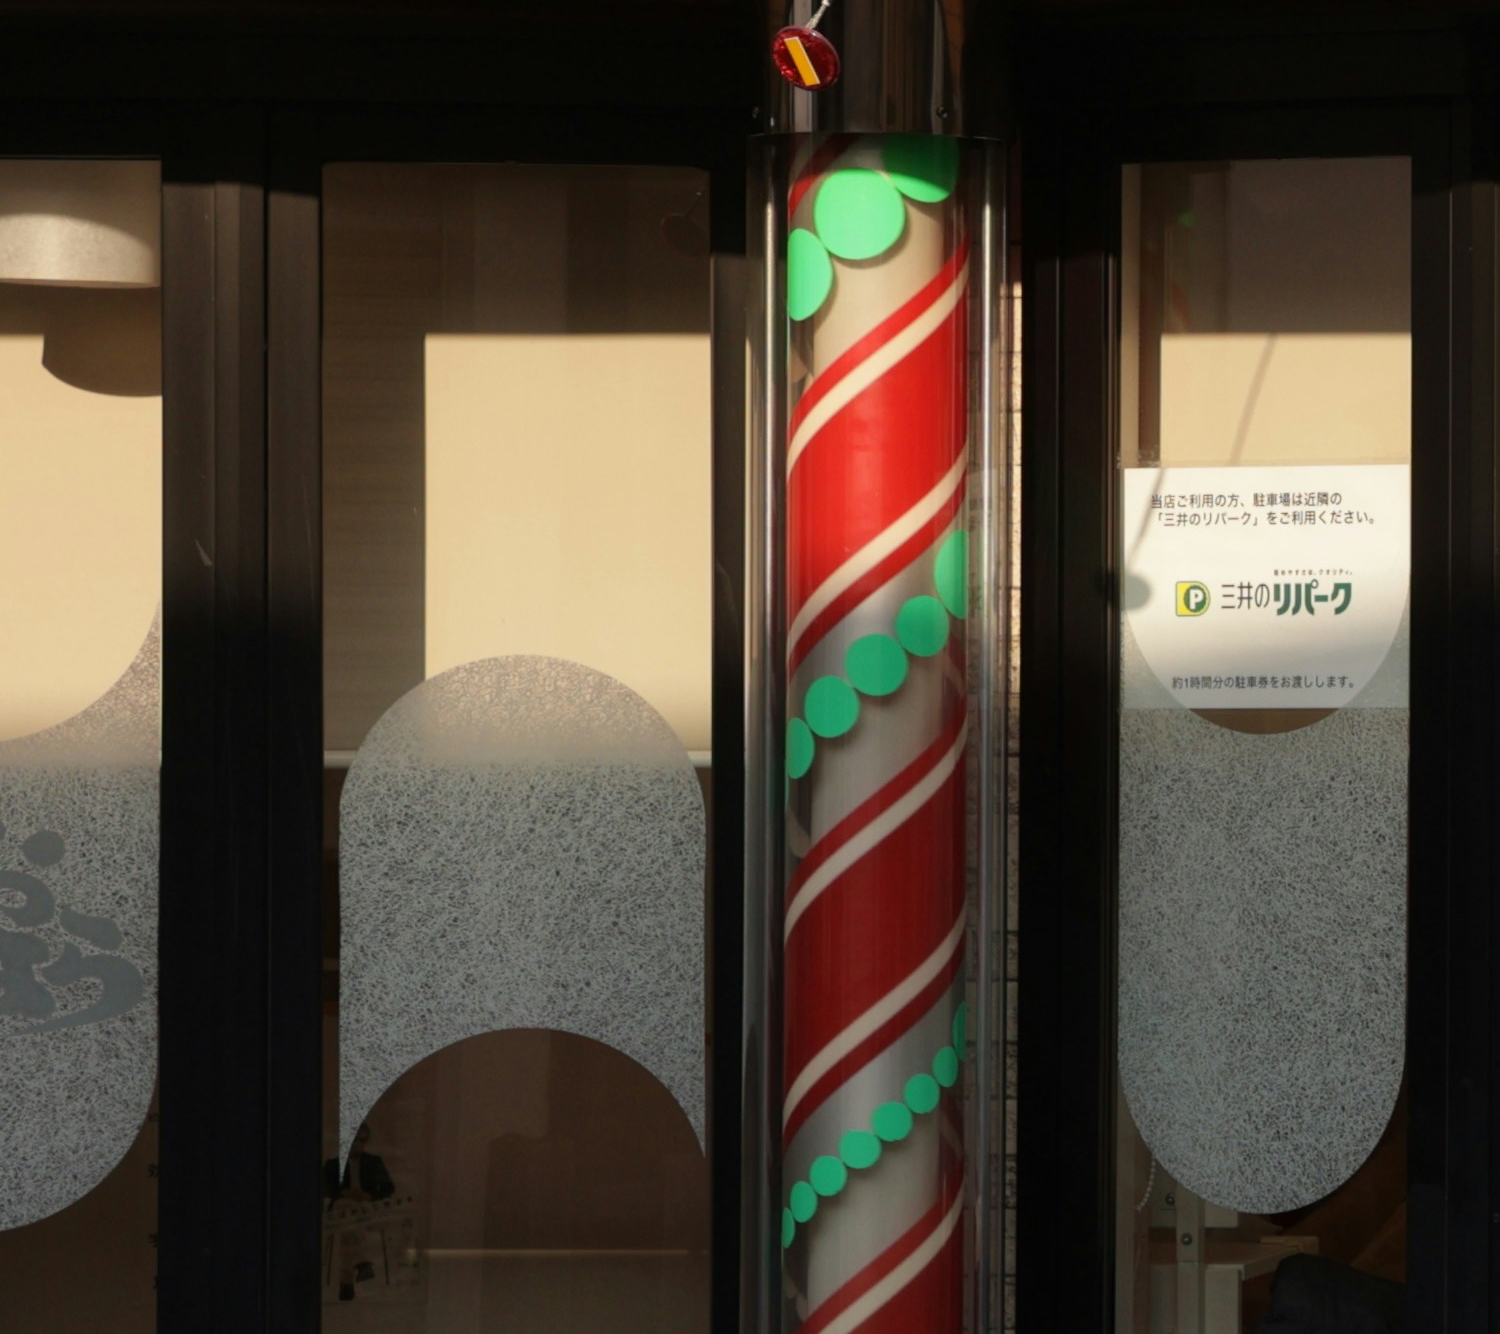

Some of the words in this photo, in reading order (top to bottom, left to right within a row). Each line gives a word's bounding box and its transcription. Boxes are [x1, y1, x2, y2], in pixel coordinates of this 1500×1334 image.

[1150, 491, 1343, 510] 当店ご利用の方、駐車場は近隣の
[1156, 510, 1376, 528] 「三井のリパーク」をご利用ください。
[1220, 578, 1353, 617] 三井のリパーク
[1171, 675, 1356, 690] 約1時間分の駐車券をお渡しします。
